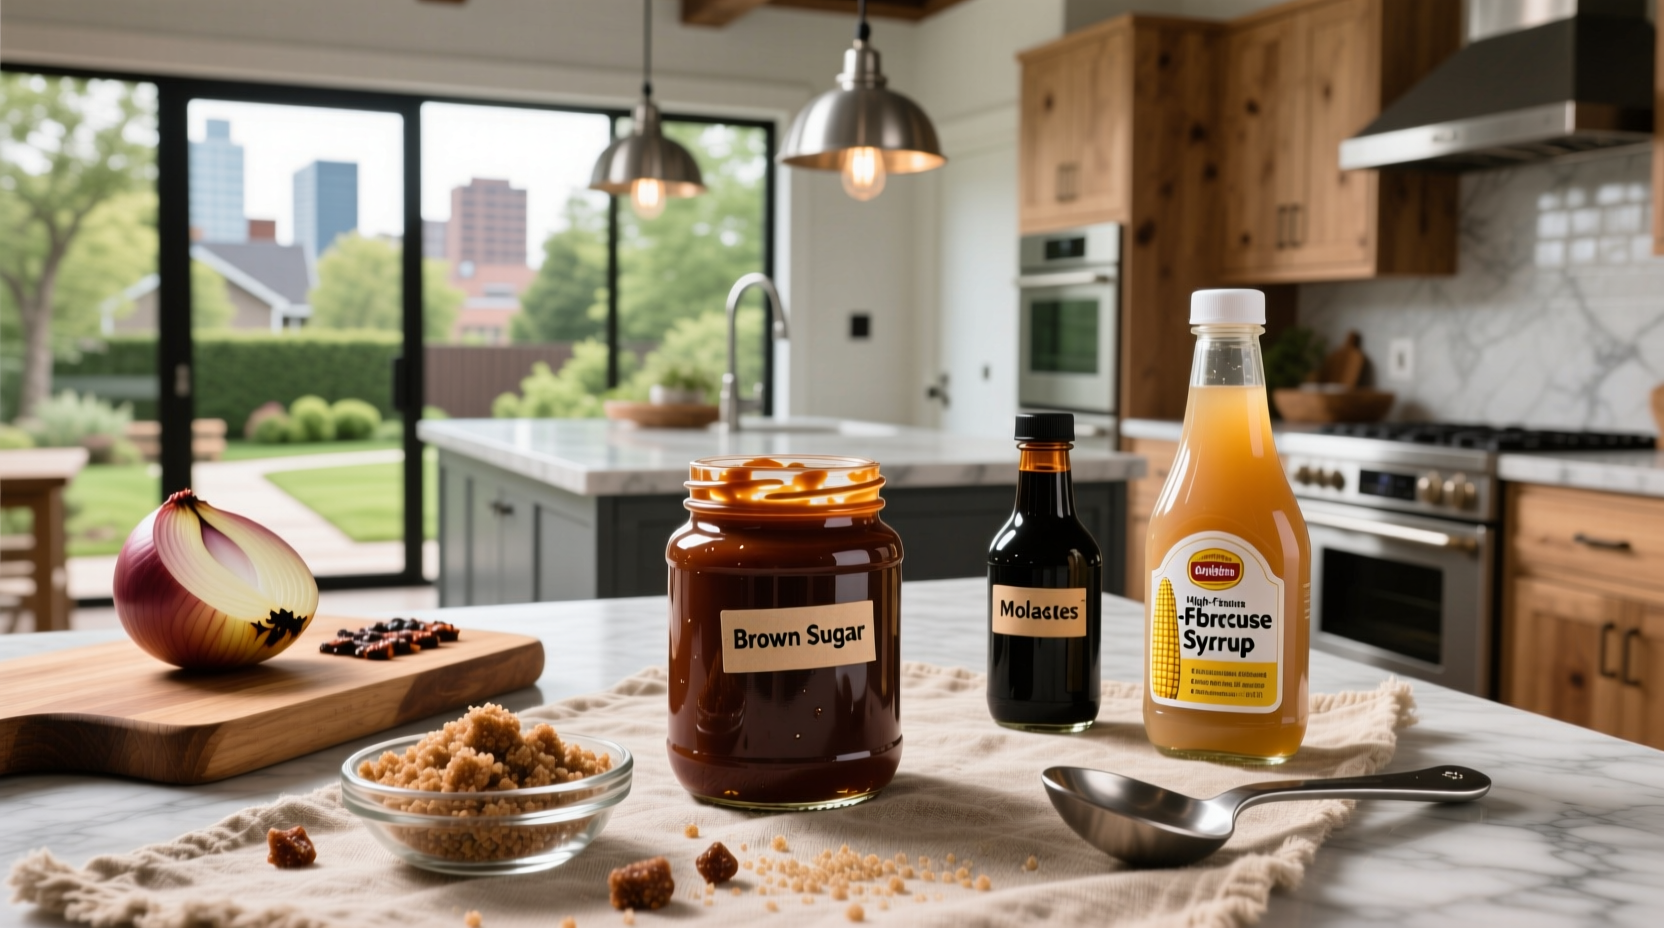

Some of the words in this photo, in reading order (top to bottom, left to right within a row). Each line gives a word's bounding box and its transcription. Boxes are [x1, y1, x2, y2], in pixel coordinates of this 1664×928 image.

[733, 629, 801, 649] Brown
[806, 624, 866, 649] Sugar
[1183, 629, 1255, 658] Syrrup
